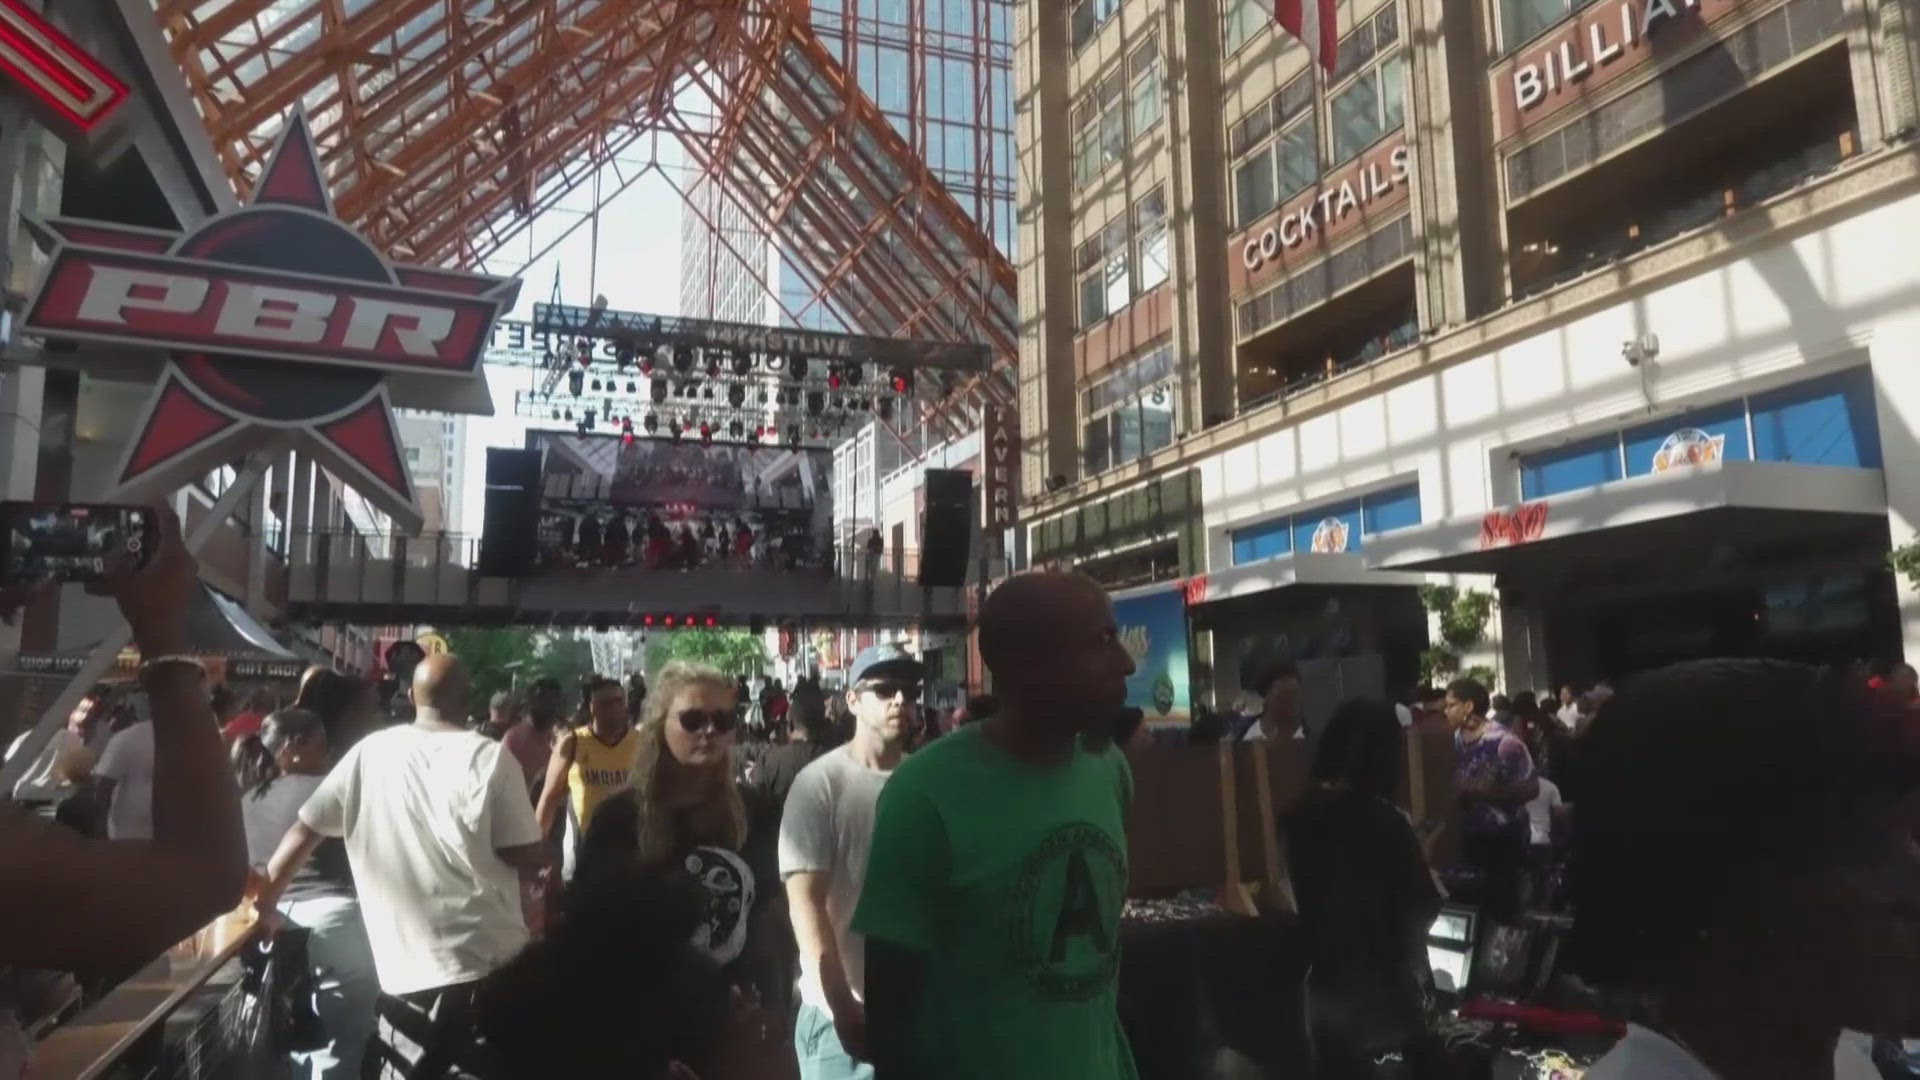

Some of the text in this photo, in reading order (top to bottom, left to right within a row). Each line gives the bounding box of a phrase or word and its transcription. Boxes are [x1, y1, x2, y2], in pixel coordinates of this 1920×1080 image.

[1513, 0, 1696, 110] BILLIA
[1243, 145, 1409, 270] COCKTAILS
[76, 264, 457, 358] PBR
[993, 405, 1009, 523] TAVERN
[235, 662, 301, 677] GIFT SHOP
